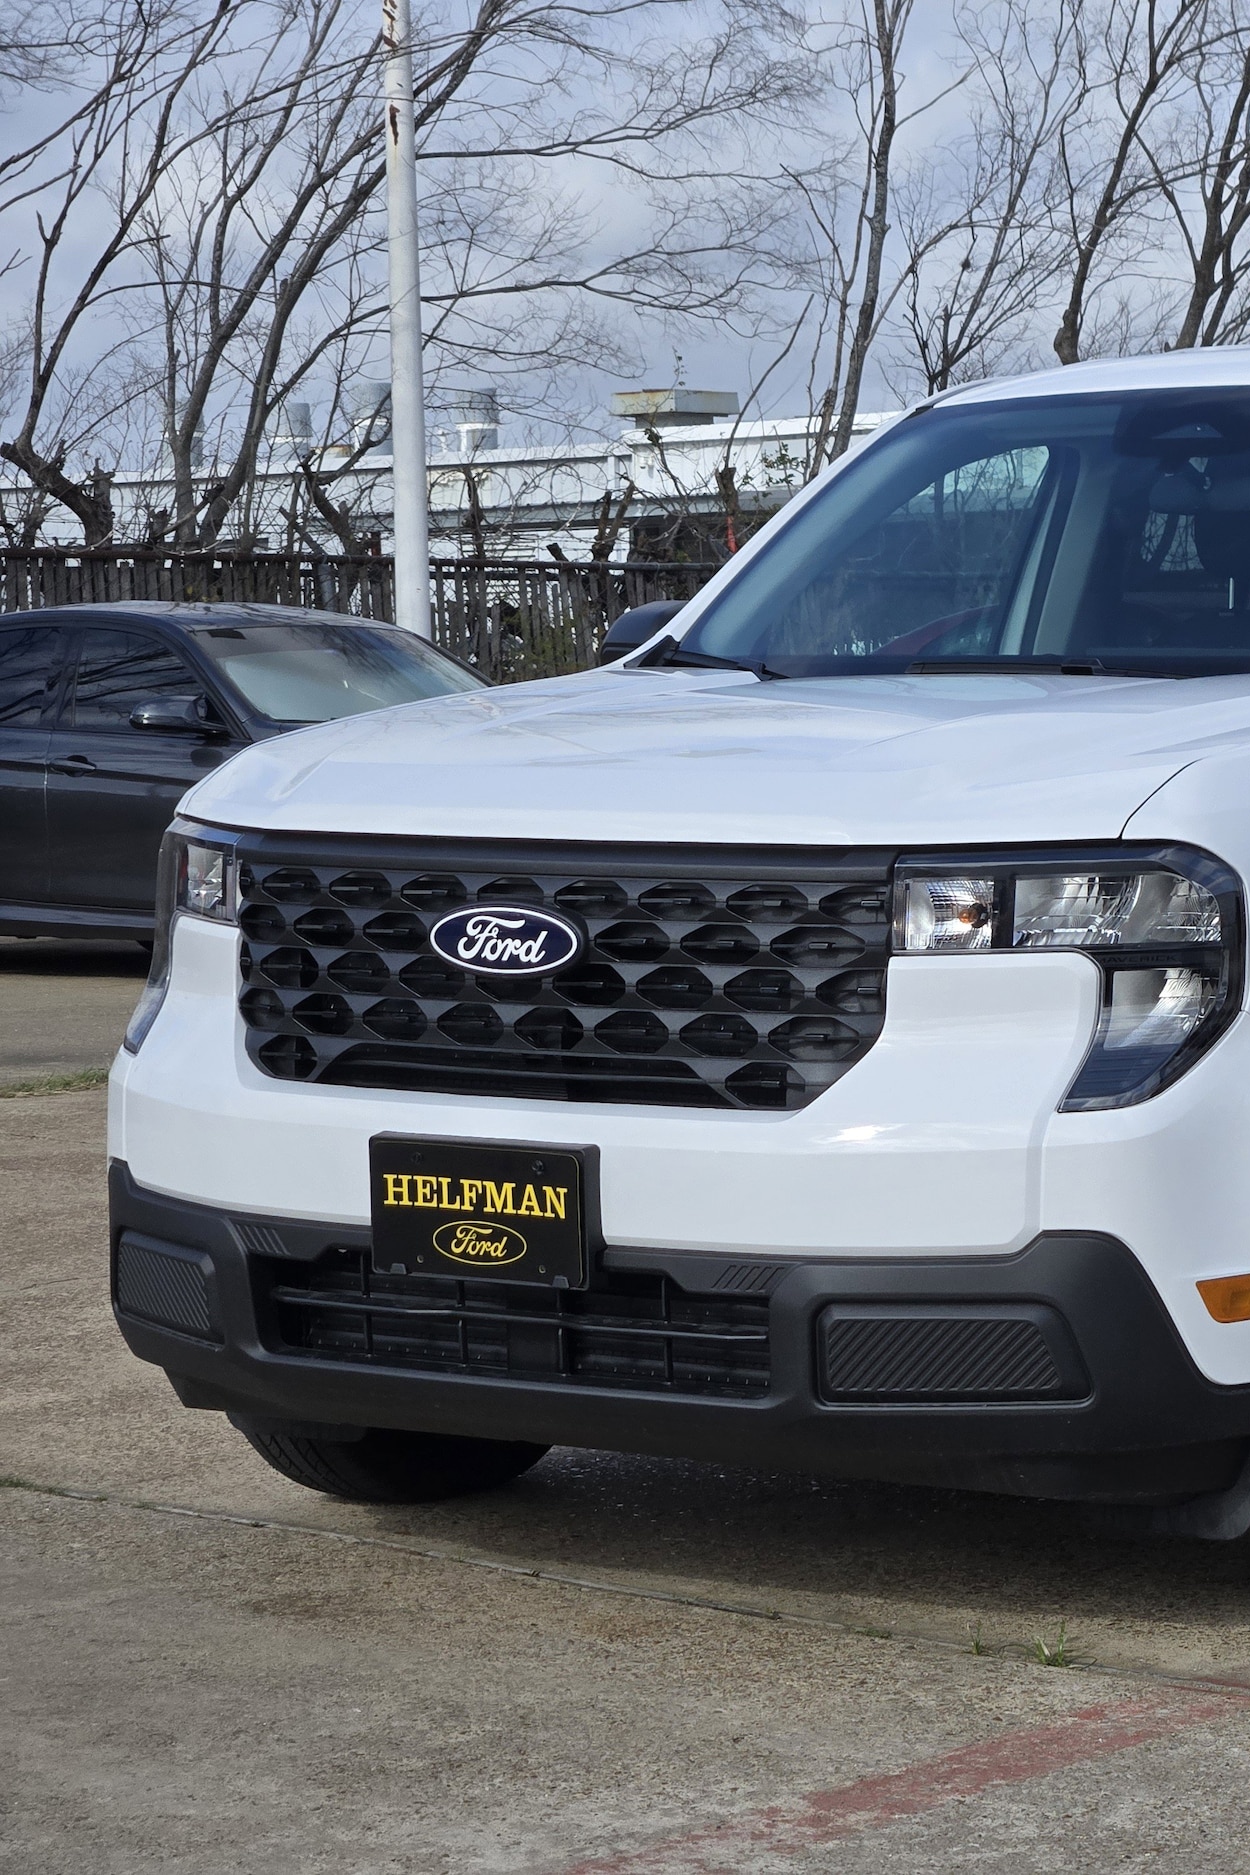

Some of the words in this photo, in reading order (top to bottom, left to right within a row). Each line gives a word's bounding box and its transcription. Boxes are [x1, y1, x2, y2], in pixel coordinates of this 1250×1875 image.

[457, 915, 549, 963] Ford
[383, 1173, 568, 1220] HELFMAN
[450, 1225, 508, 1257] Ford
